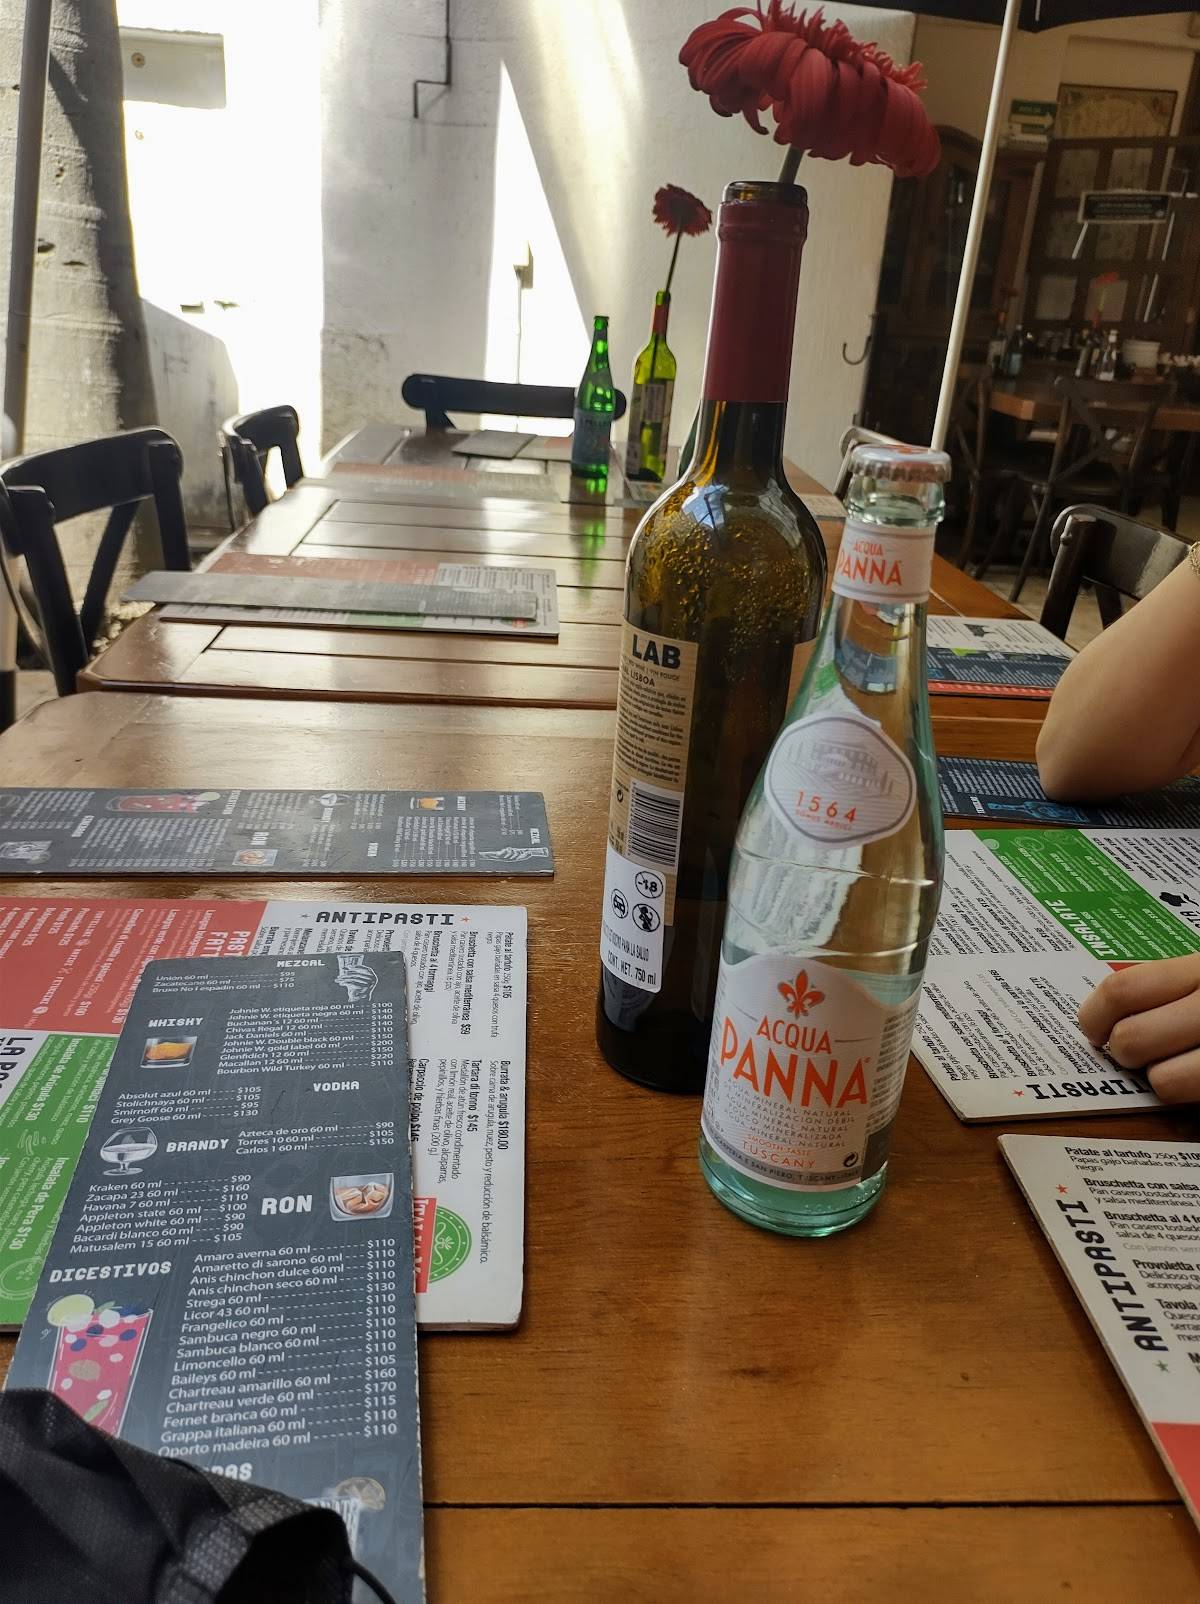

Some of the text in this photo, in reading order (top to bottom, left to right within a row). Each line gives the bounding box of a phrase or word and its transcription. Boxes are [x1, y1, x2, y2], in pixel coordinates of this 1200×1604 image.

[854, 541, 883, 556] ACQUA
[632, 634, 680, 669] LAB
[630, 672, 655, 686] LISBOA
[796, 791, 857, 823] 1564
[316, 911, 454, 926] ANTIPASTI
[1044, 900, 1118, 956] INSALATE
[276, 959, 326, 968] MEZCAL
[635, 968, 646, 982] 750
[648, 973, 656, 985] ml
[148, 1017, 204, 1027] WHISKY
[756, 1014, 832, 1055] ACQUA
[720, 1016, 868, 1108] PANNA
[313, 1080, 360, 1094] VODKA
[1026, 1079, 1150, 1099] TIPASTI
[166, 1138, 230, 1154] BRANDY
[743, 1139, 816, 1168] TUSCANY
[1064, 1146, 1100, 1156] Patate
[1116, 1150, 1150, 1159] tartufo
[42, 1157, 69, 1190] Insalata
[147, 1180, 162, 1188] ml
[1084, 1178, 1144, 1188] Bruschetta
[1170, 1182, 1199, 1191] salsa
[34, 1192, 49, 1202] de
[262, 1194, 312, 1216] RON
[22, 1205, 44, 1224] Pera
[80, 1212, 134, 1222] Appleton
[186, 1206, 201, 1214] ml
[220, 1203, 246, 1212] $100
[1104, 1211, 1168, 1222] Bruschetta
[1171, 1214, 1180, 1222] al
[9, 1227, 32, 1249] $130
[74, 1232, 117, 1242] Bacardi
[120, 1231, 159, 1239] blanco
[178, 1226, 193, 1234] ml
[223, 1223, 244, 1231] $90
[194, 1238, 395, 1262] Amaro averna 60 ml $110
[192, 1249, 395, 1273] Amaretto di sarono 60 ml $110
[1132, 1259, 1194, 1271] Provoletta
[50, 1261, 172, 1284] DIGESTIVOS
[1056, 1200, 1169, 1351] ANTIPASTI
[186, 1282, 395, 1308] Strega 60 ml $130
[1155, 1298, 1198, 1310] Tavola
[182, 1305, 395, 1332] Frangelico 60 ml $110
[161, 1409, 396, 1442] Grappa italiana 60 ml $110
